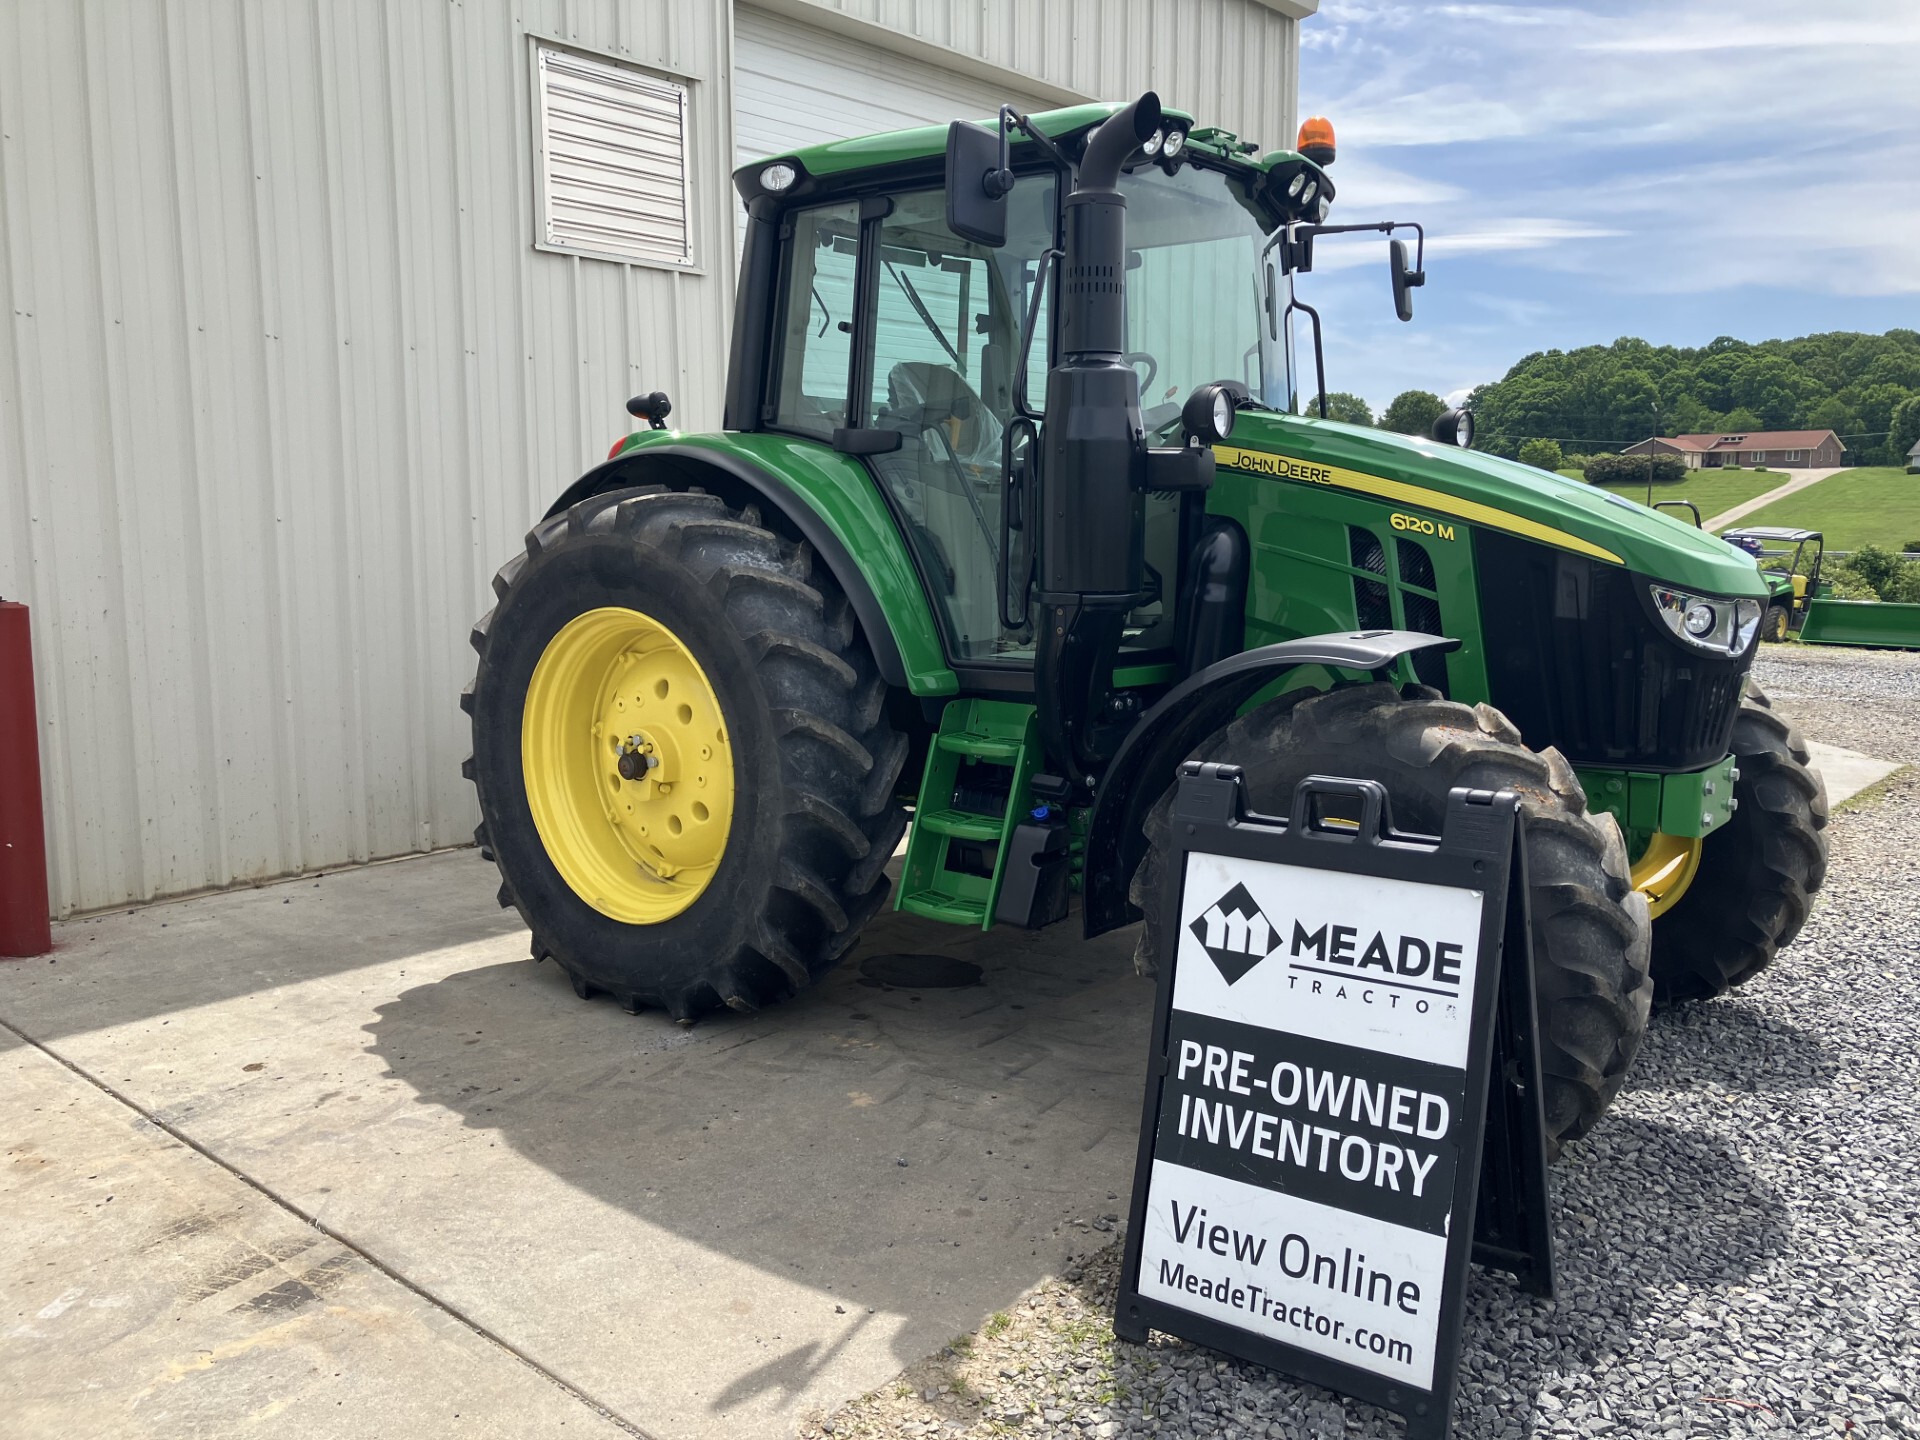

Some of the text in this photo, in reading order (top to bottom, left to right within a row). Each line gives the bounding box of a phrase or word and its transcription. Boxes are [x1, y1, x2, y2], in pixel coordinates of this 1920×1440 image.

[1232, 451, 1331, 483] JOHN DEERE
[1389, 512, 1455, 541] 6120 M
[1290, 918, 1464, 985] MEADE
[1287, 975, 1457, 1021] TRACTO
[1177, 1039, 1450, 1141] PRE-OWNED
[1177, 1094, 1438, 1198] INVENTORY
[1170, 1199, 1421, 1315] View Online
[1159, 1258, 1413, 1365] MeadeTractor.com
